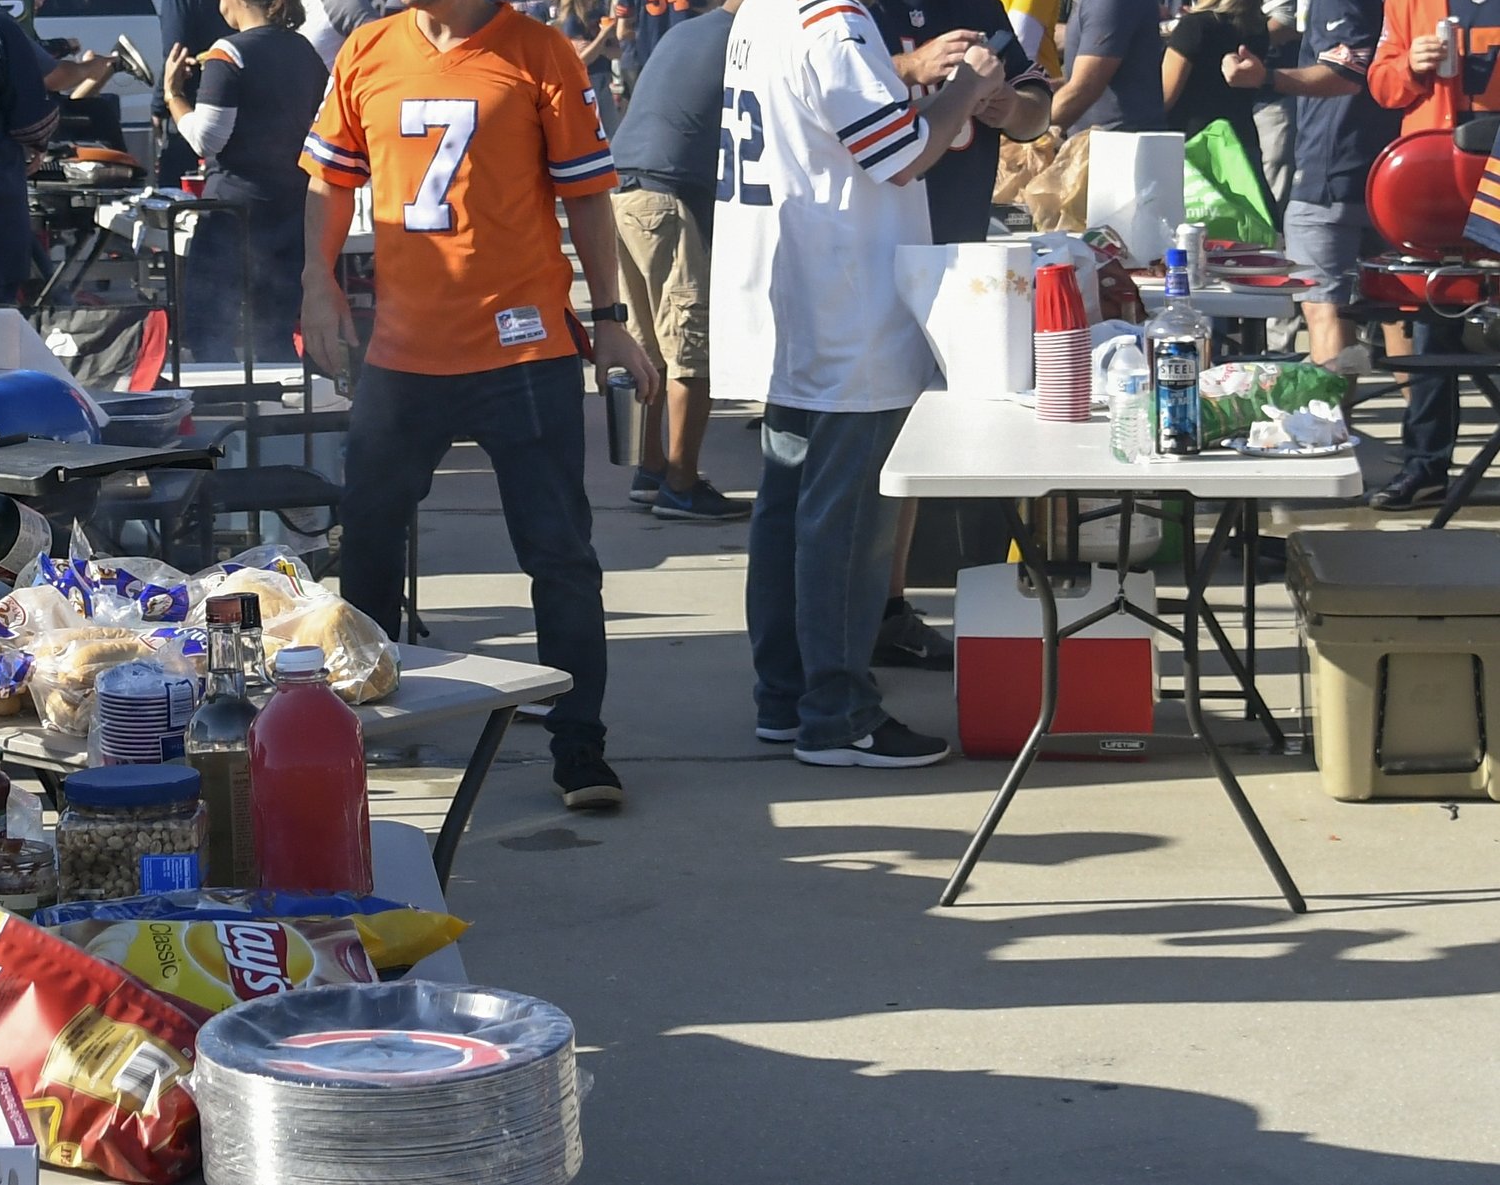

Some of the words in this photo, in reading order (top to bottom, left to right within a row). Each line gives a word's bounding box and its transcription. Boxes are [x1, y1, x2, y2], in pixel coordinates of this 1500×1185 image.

[399, 97, 479, 234] 7
[1160, 364, 1194, 375] STEEL
[149, 923, 179, 980] Classic
[213, 920, 299, 995] Lay's
